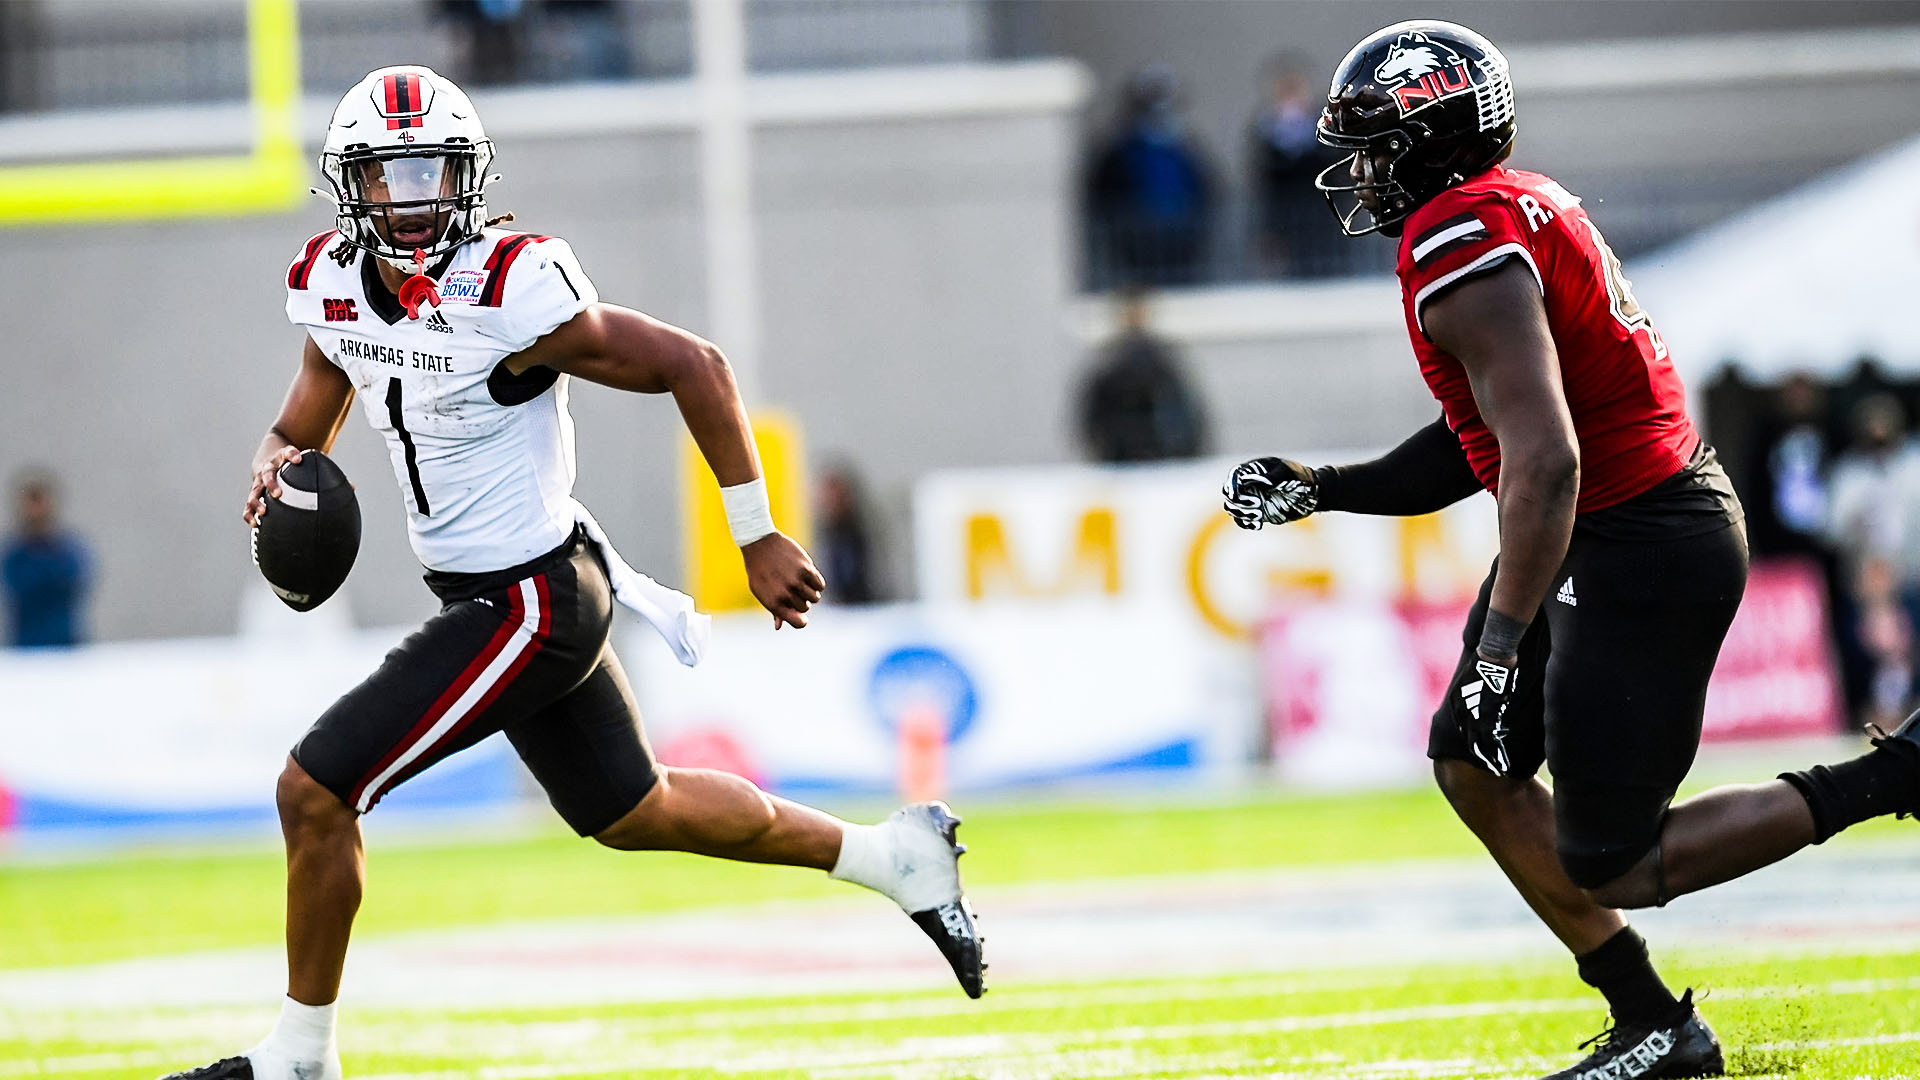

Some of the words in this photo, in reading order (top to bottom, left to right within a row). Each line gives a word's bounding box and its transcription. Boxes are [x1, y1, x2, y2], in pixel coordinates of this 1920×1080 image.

[1393, 64, 1469, 111] NIU
[1516, 193, 1555, 233] R.
[441, 283, 480, 297] BOWL
[552, 260, 581, 302] 1
[426, 323, 454, 333] adidas
[340, 338, 404, 367] ARKANSAS
[412, 351, 454, 373] STATE
[384, 376, 431, 518] 1
[1556, 592, 1578, 607] adidas
